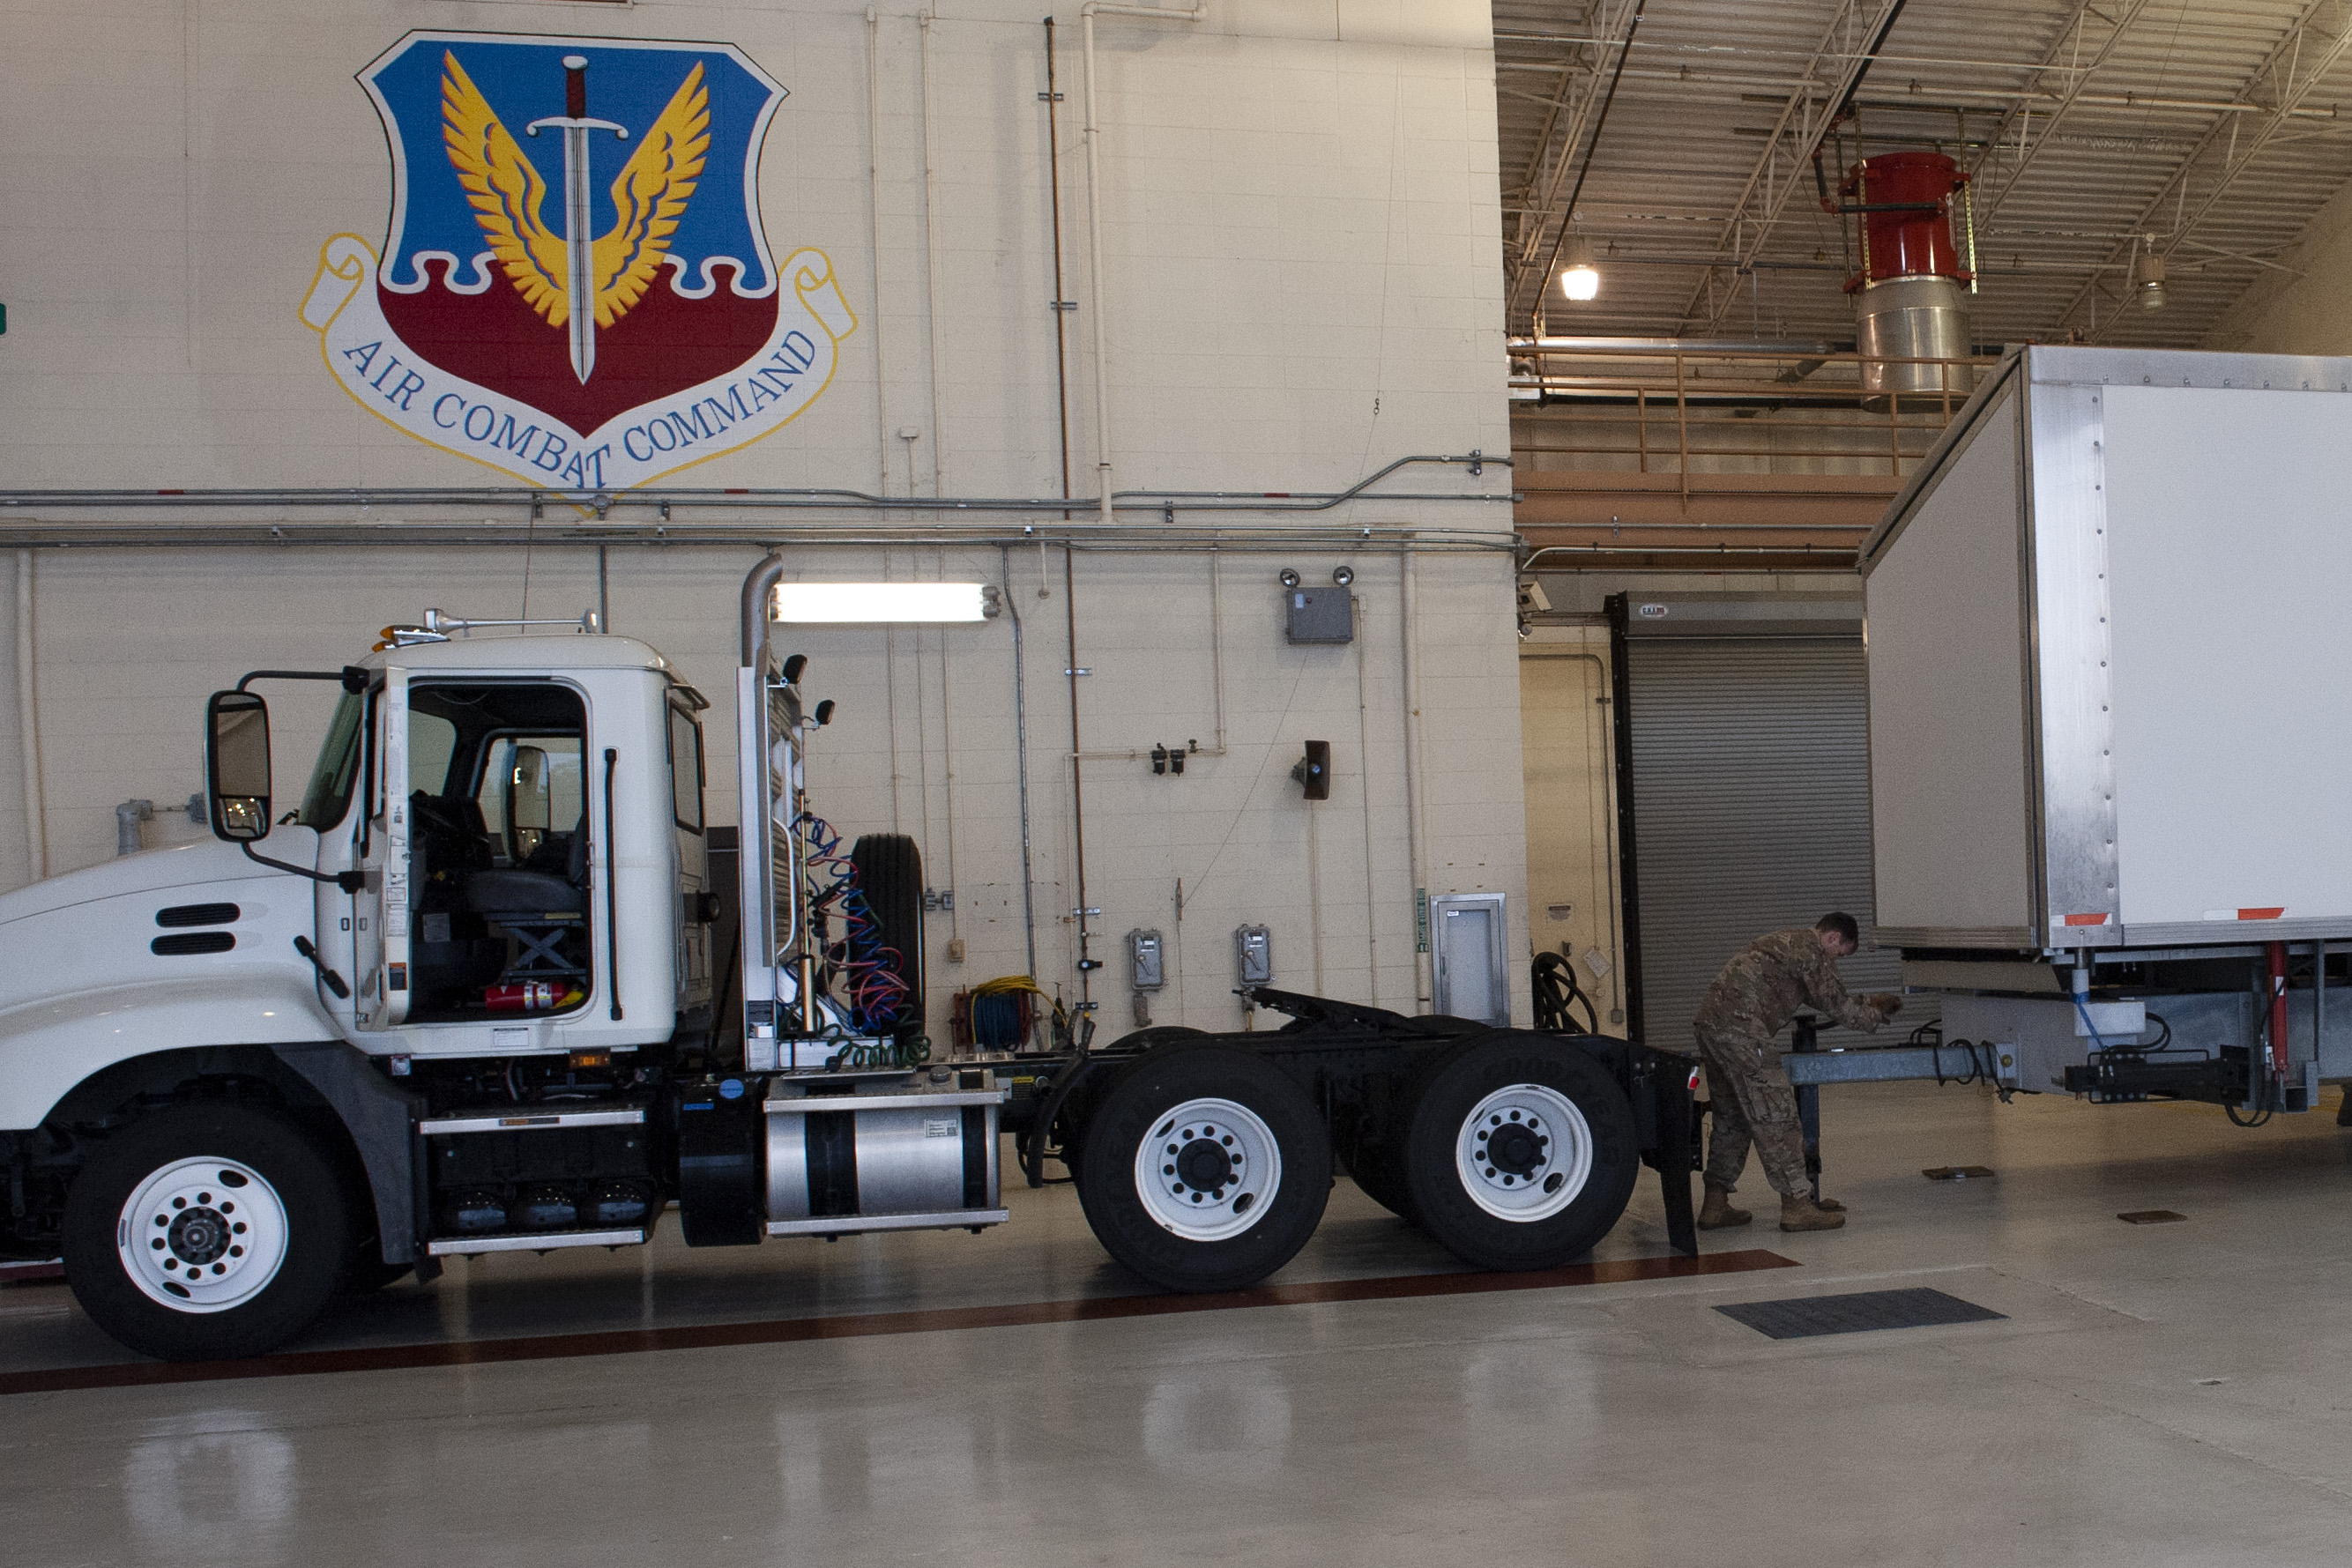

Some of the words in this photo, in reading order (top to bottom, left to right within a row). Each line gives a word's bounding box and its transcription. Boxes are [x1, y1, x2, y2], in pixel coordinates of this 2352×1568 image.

[343, 341, 425, 411] AIR
[432, 393, 611, 489] COMBAT
[623, 331, 815, 462] COMMAND
